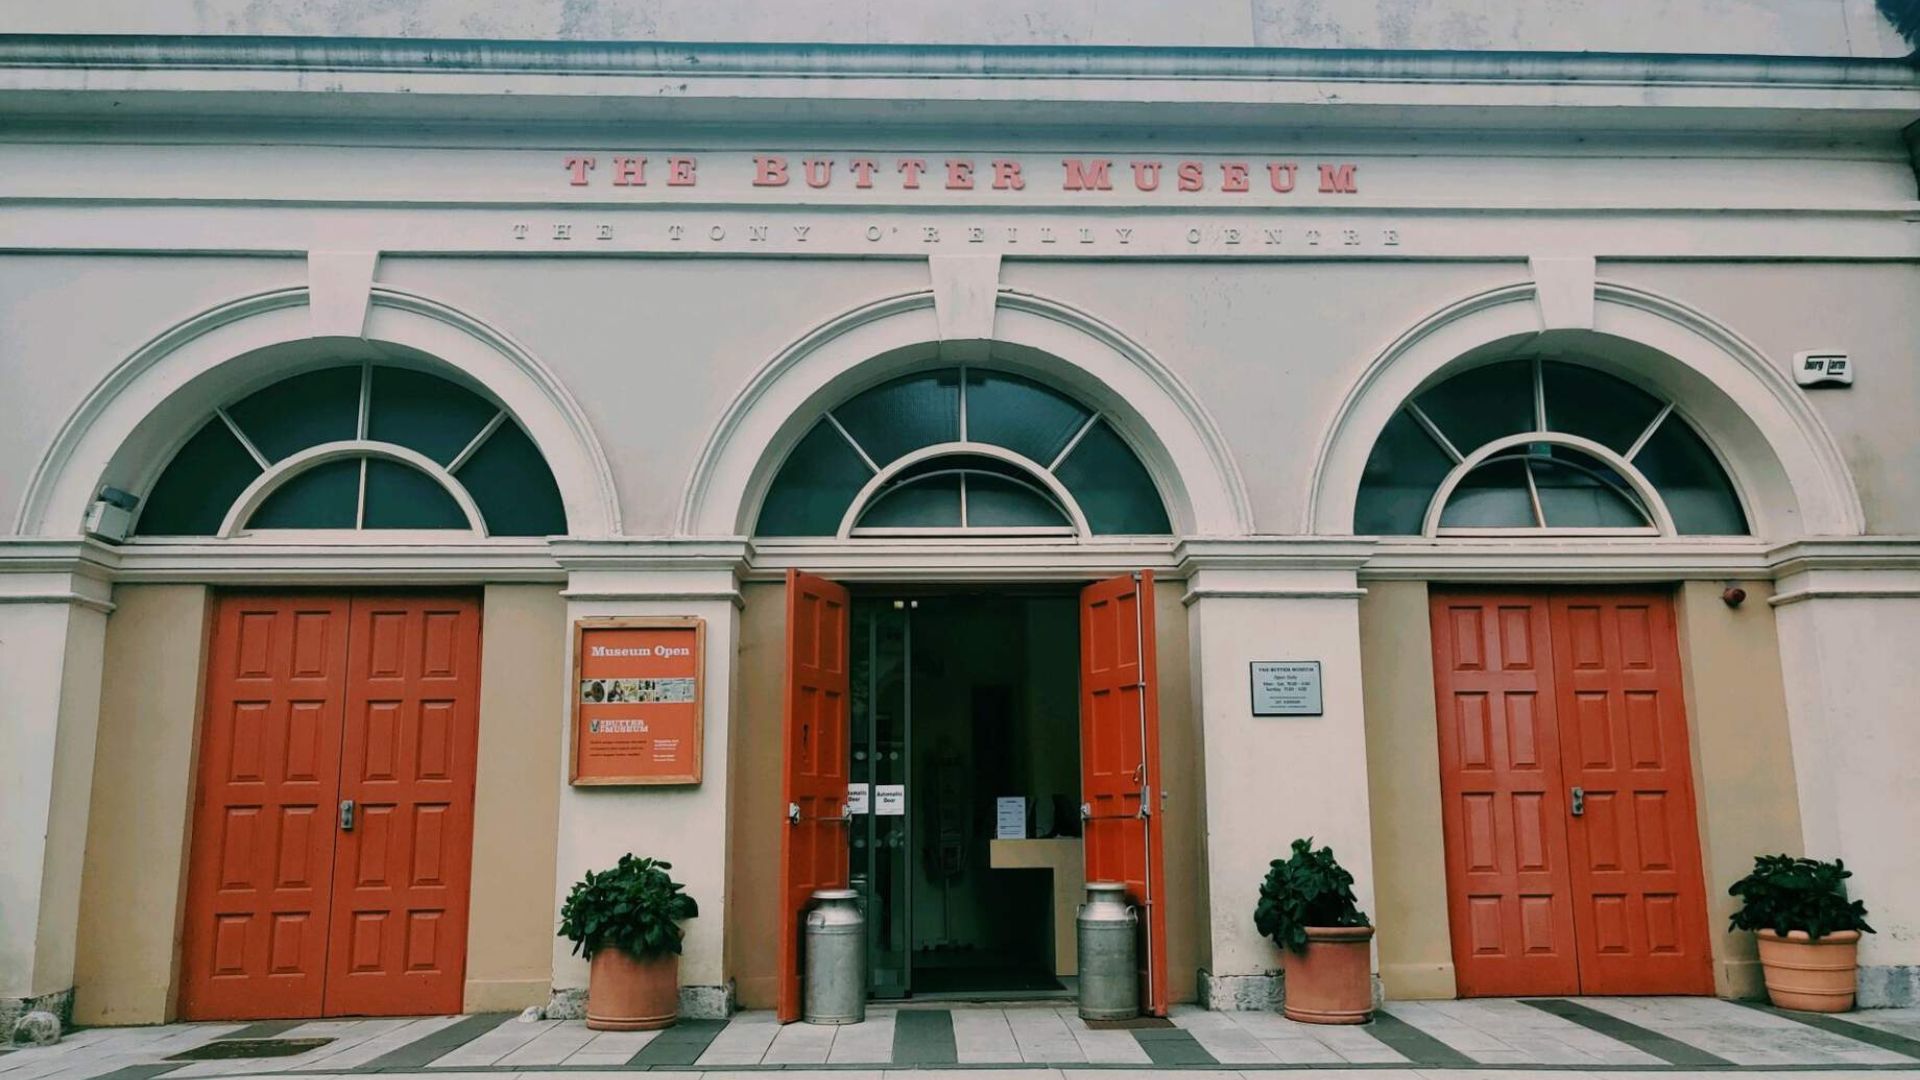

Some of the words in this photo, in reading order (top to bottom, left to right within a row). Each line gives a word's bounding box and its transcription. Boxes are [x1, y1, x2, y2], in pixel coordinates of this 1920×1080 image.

[564, 155, 697, 187] THE
[752, 155, 1027, 191] BUTTER
[1062, 159, 1359, 194] MUSEUM
[513, 224, 615, 241] THE
[668, 225, 811, 242] TONY
[864, 226, 1135, 244] O'REILLY
[1186, 227, 1402, 247] CENTRE
[591, 646, 651, 656] Museum
[654, 645, 690, 658] Open
